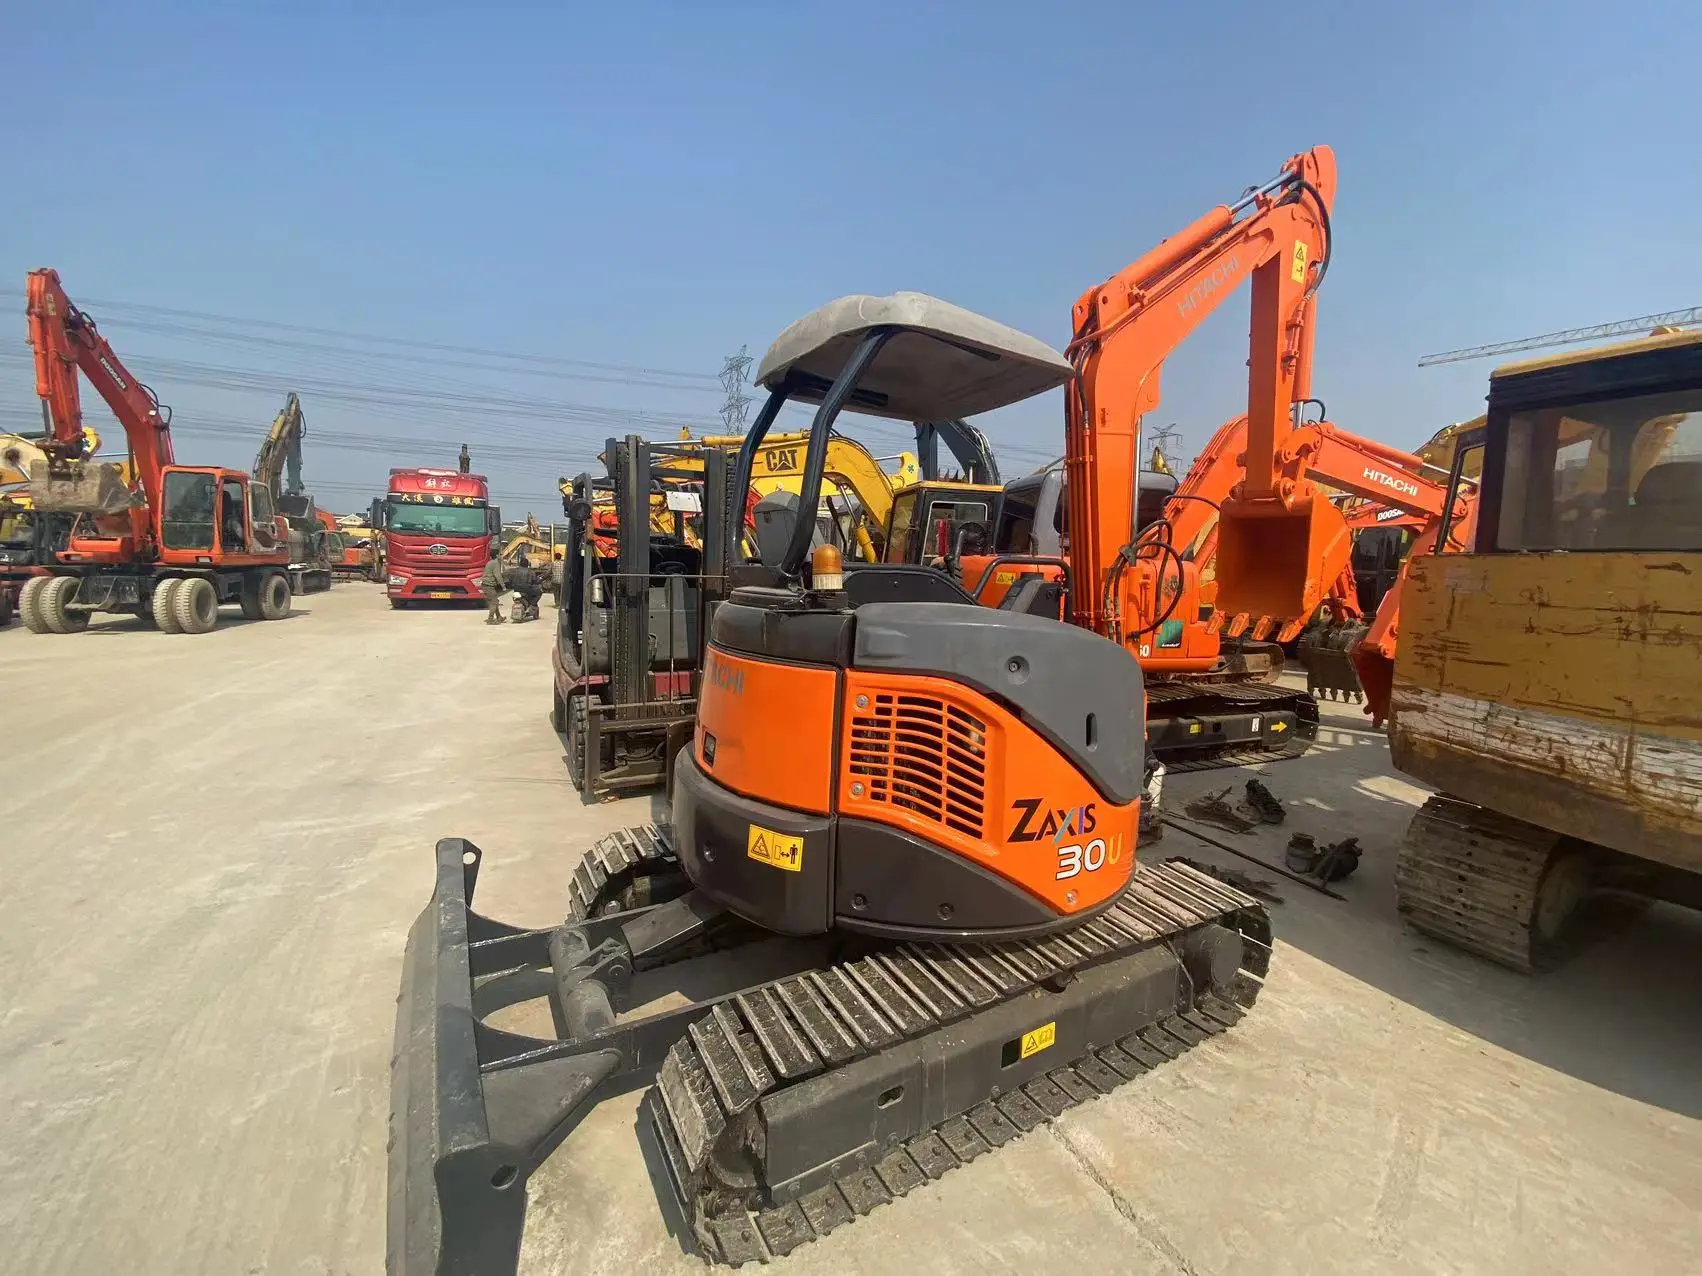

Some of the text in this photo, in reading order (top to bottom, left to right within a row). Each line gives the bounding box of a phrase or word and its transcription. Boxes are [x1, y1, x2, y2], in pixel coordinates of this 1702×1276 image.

[1176, 256, 1239, 317] HITACHI
[765, 449, 798, 472] CAT
[1363, 467, 1419, 497] HITACHI
[1007, 798, 1097, 845] ZAXIS
